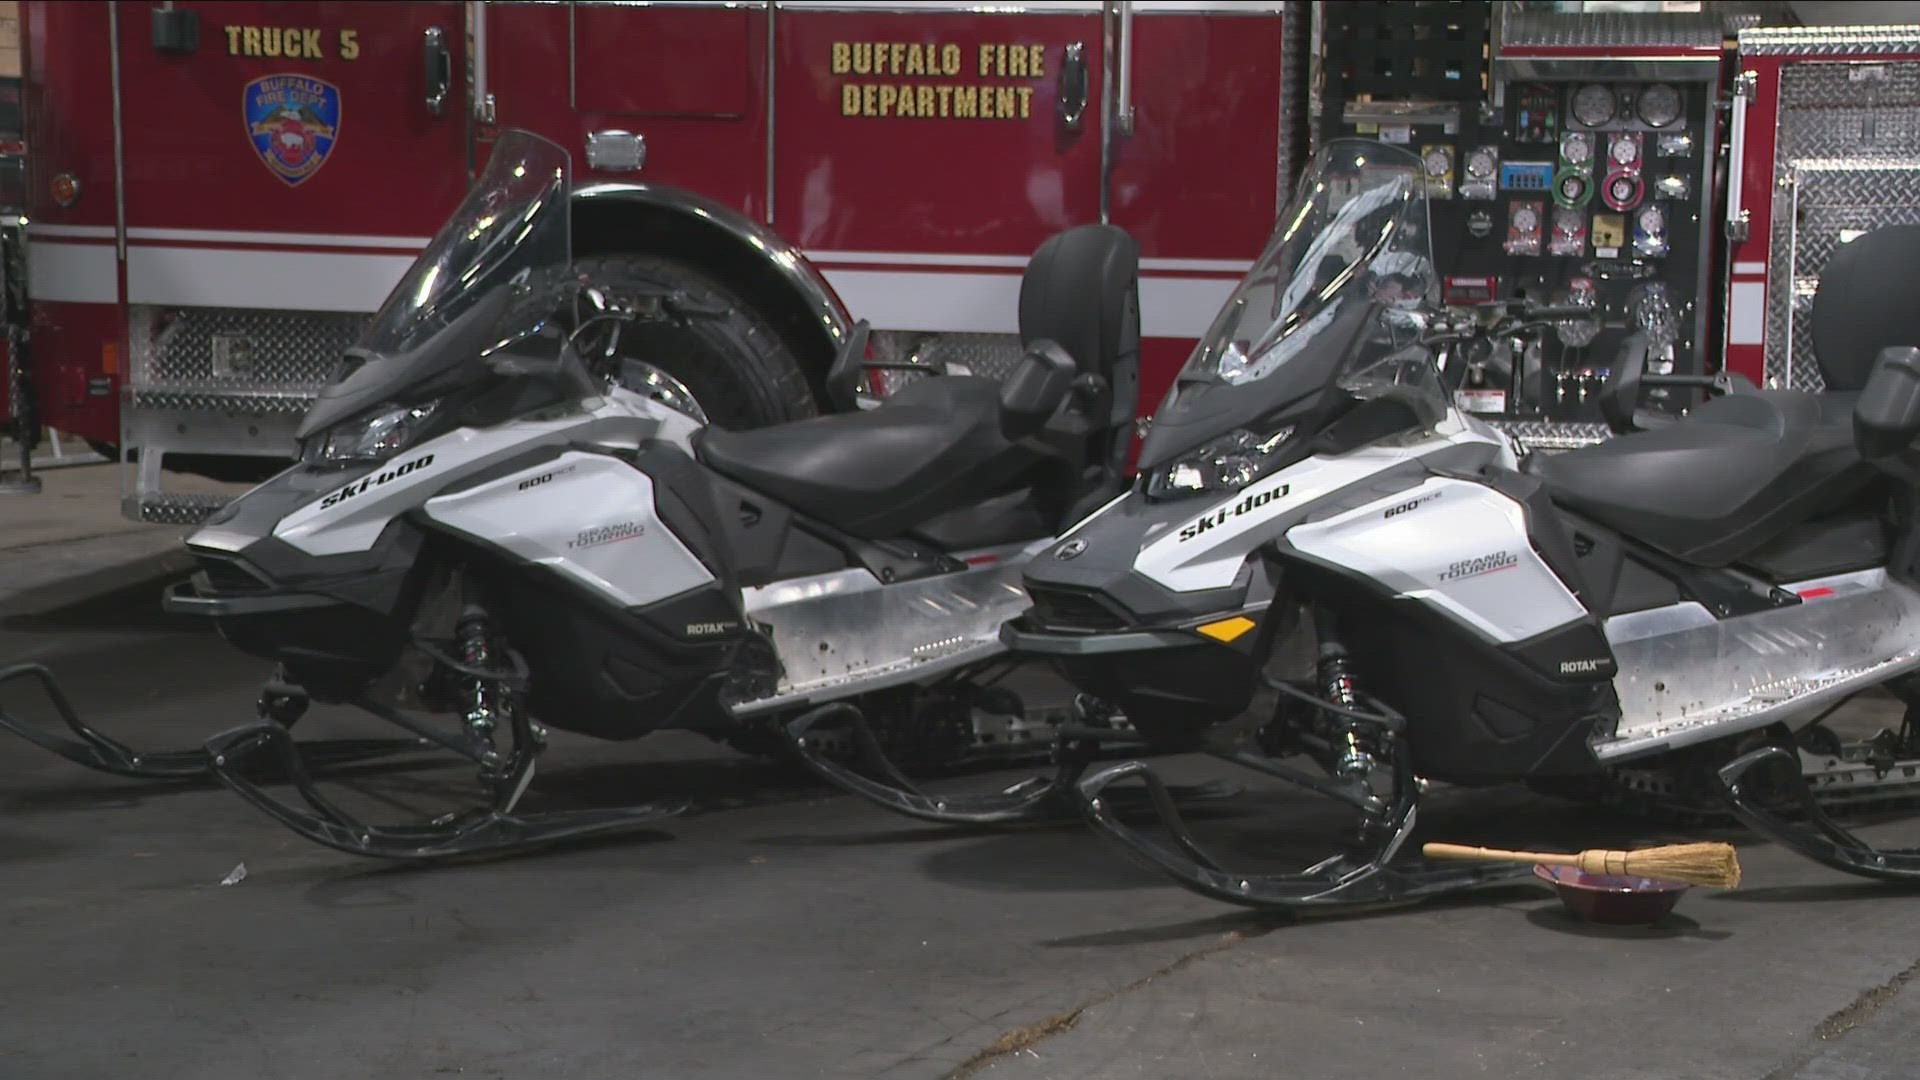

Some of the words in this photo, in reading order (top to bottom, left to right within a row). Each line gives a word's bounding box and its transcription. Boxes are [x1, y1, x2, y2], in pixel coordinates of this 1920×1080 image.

[225, 25, 323, 58] TRUCK
[340, 30, 361, 59] 5
[831, 41, 962, 76] BUFFALO
[978, 44, 1046, 77] FIRE
[260, 79, 325, 96] BUFFALO
[256, 92, 286, 107] FIRE
[841, 83, 1034, 119] DEPARTMENT
[1437, 554, 1519, 581] TOURING
[1448, 550, 1507, 571] GRAND
[686, 622, 726, 635] ROTAX
[1560, 659, 1598, 673] ROTAX
